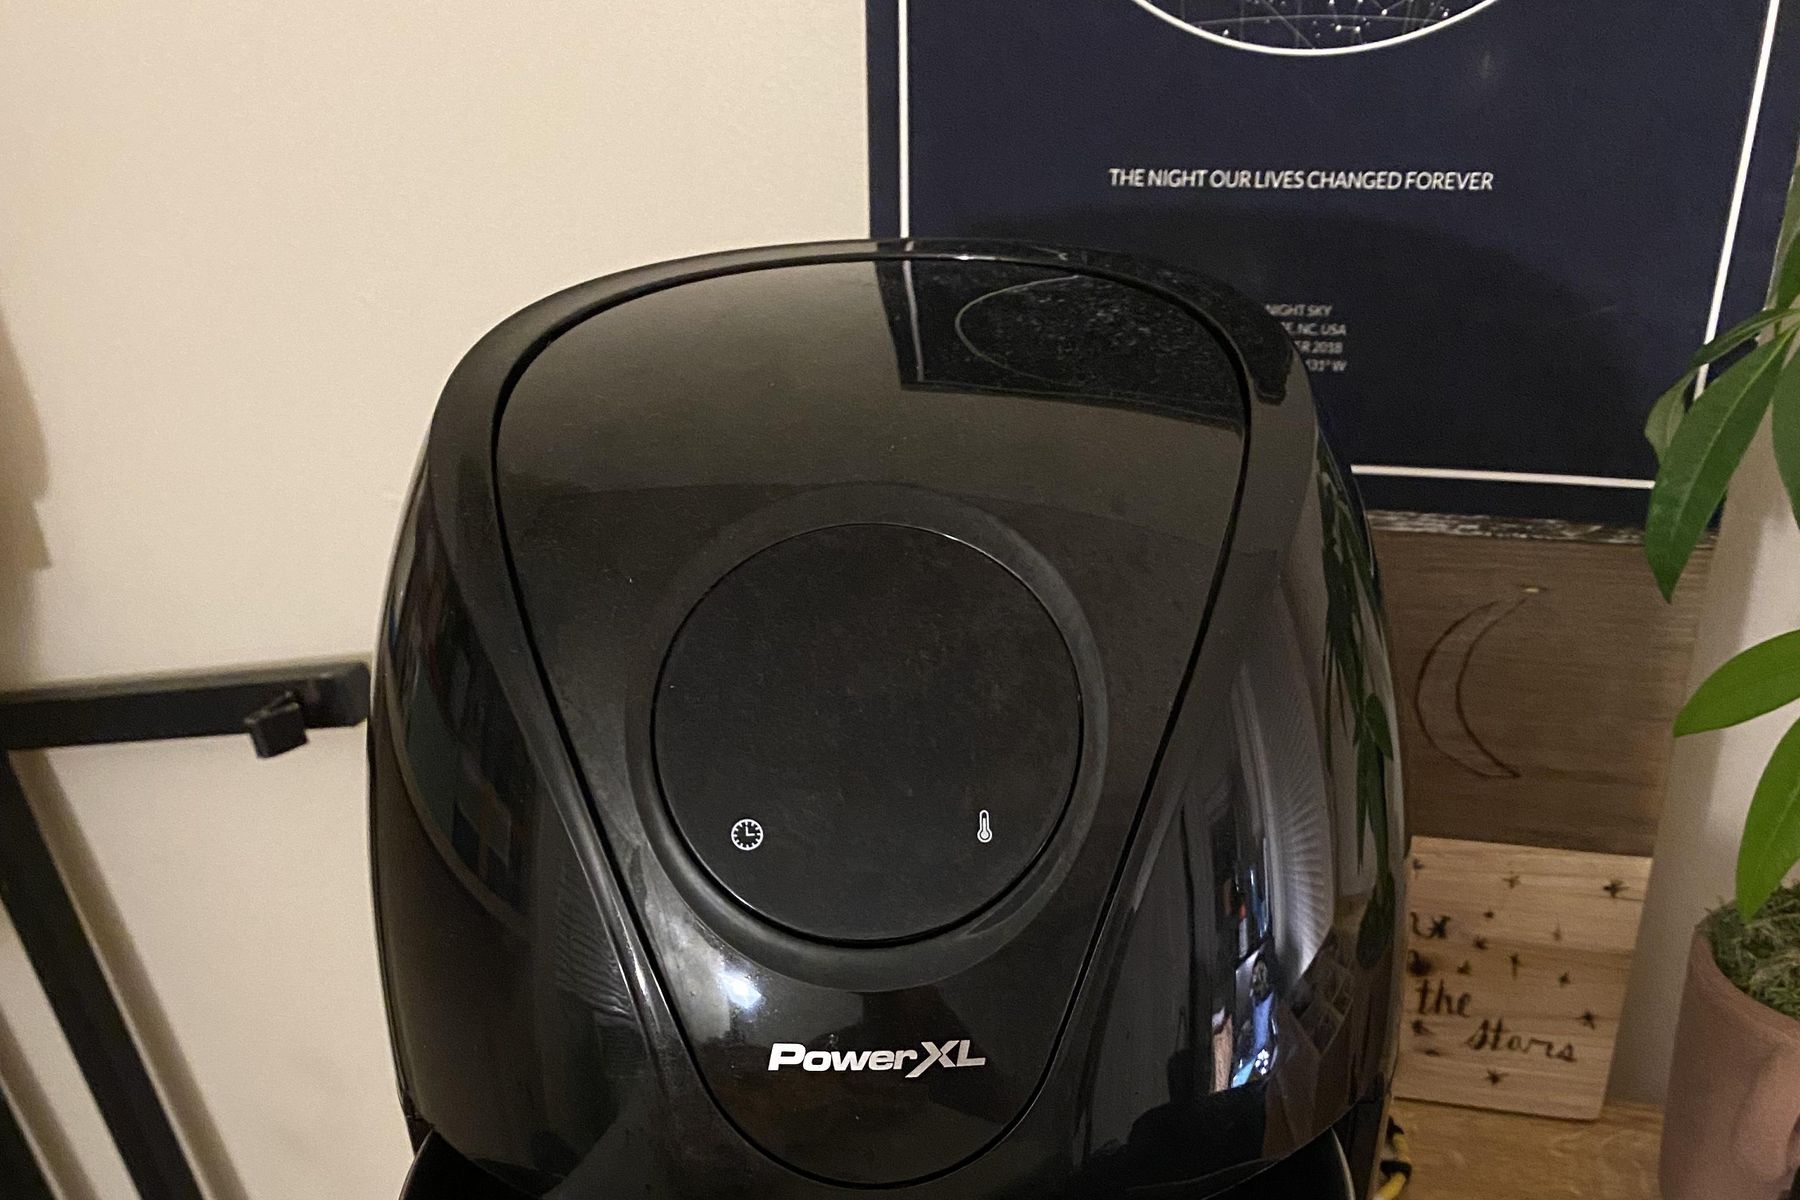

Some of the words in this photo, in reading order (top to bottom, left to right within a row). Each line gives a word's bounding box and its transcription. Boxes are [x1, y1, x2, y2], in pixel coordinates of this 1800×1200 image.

[1109, 167, 1145, 188] THE
[1147, 168, 1208, 188] NIGHT
[1209, 169, 1251, 189] OUR
[1254, 170, 1304, 190] LIVES
[1306, 170, 1402, 190] CHANGED
[1404, 171, 1494, 191] FOREVER
[1415, 978, 1471, 1018] the
[768, 1040, 985, 1077] PowerXL
